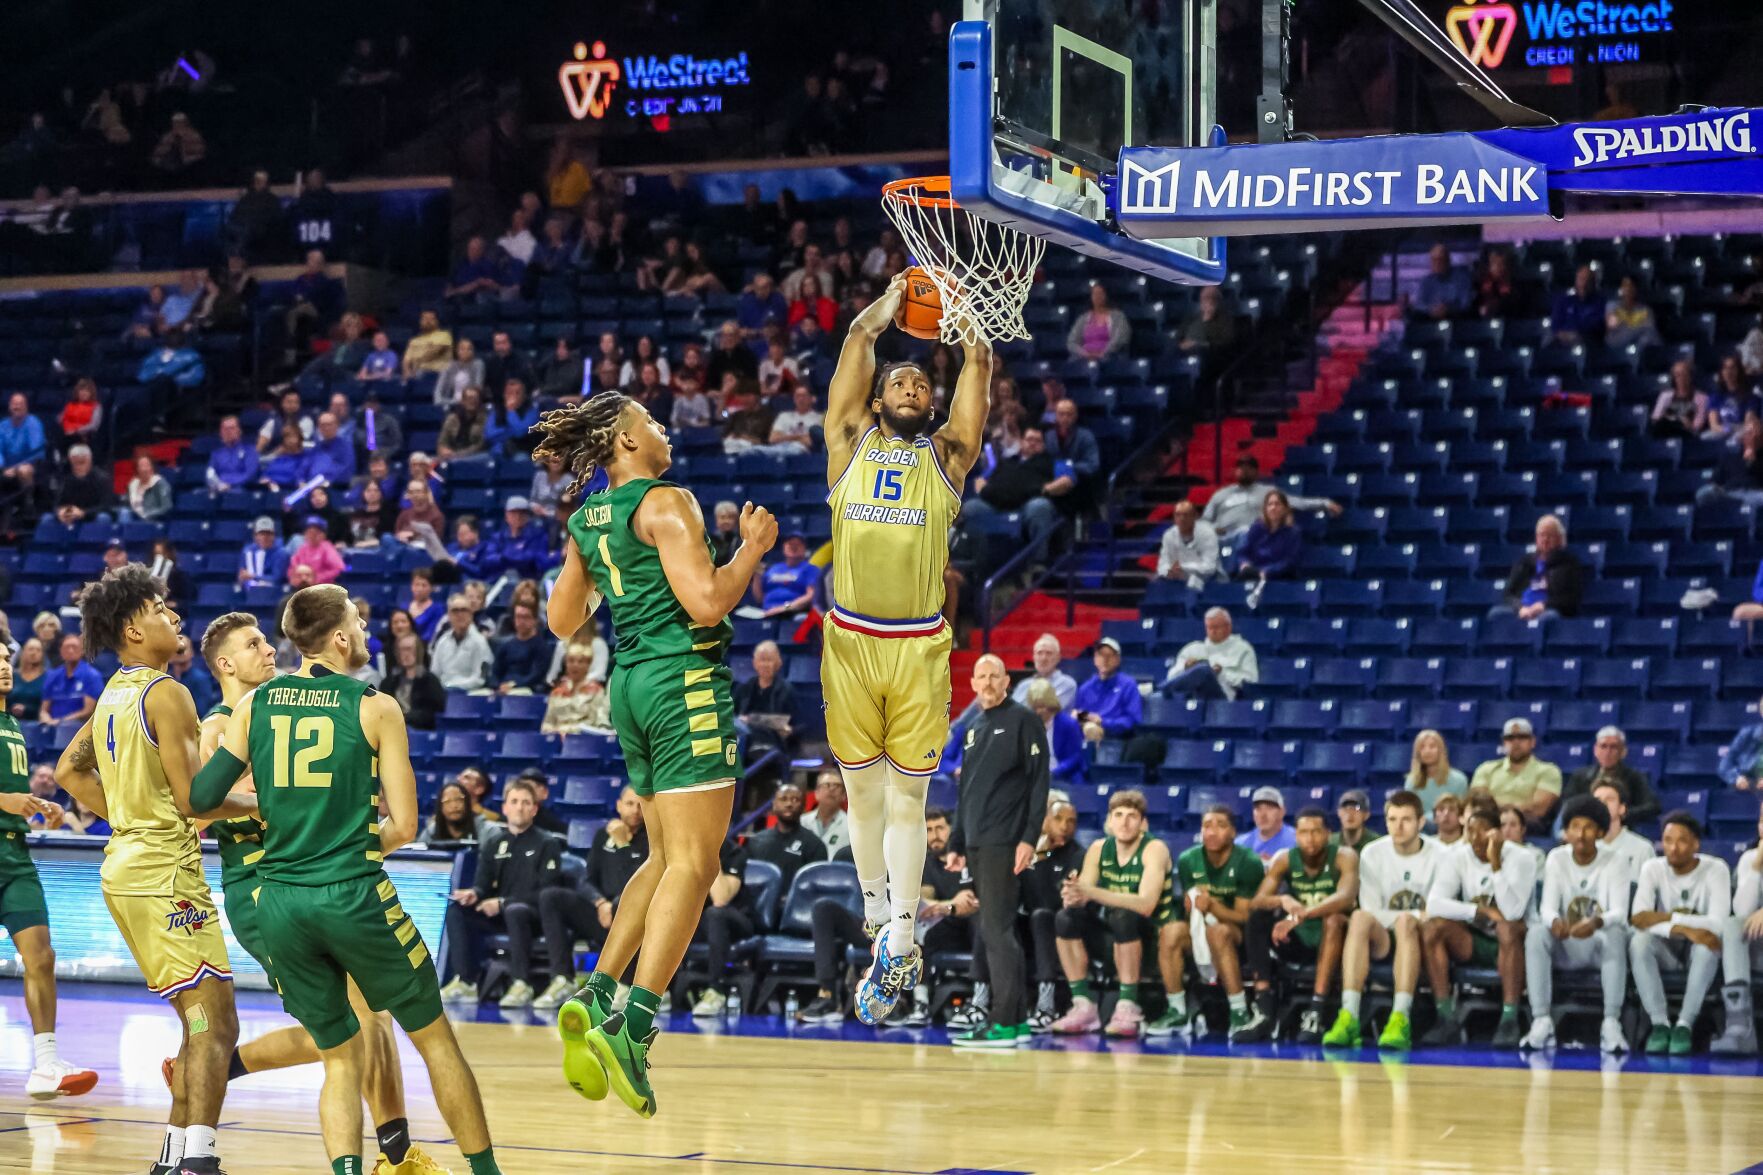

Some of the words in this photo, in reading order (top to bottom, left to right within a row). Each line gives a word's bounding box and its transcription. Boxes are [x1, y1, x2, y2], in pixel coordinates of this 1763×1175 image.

[1573, 112, 1750, 167] SPALDING
[1416, 164, 1540, 205] BANK
[300, 221, 331, 241] 104
[872, 468, 904, 502] 15
[844, 502, 927, 527] HURRICANE
[597, 534, 626, 597] 1
[267, 687, 341, 708] THREADGILL
[106, 713, 117, 764] 4
[270, 714, 335, 788] 12
[6, 741, 29, 777] 10
[165, 906, 209, 932] Tulsa
